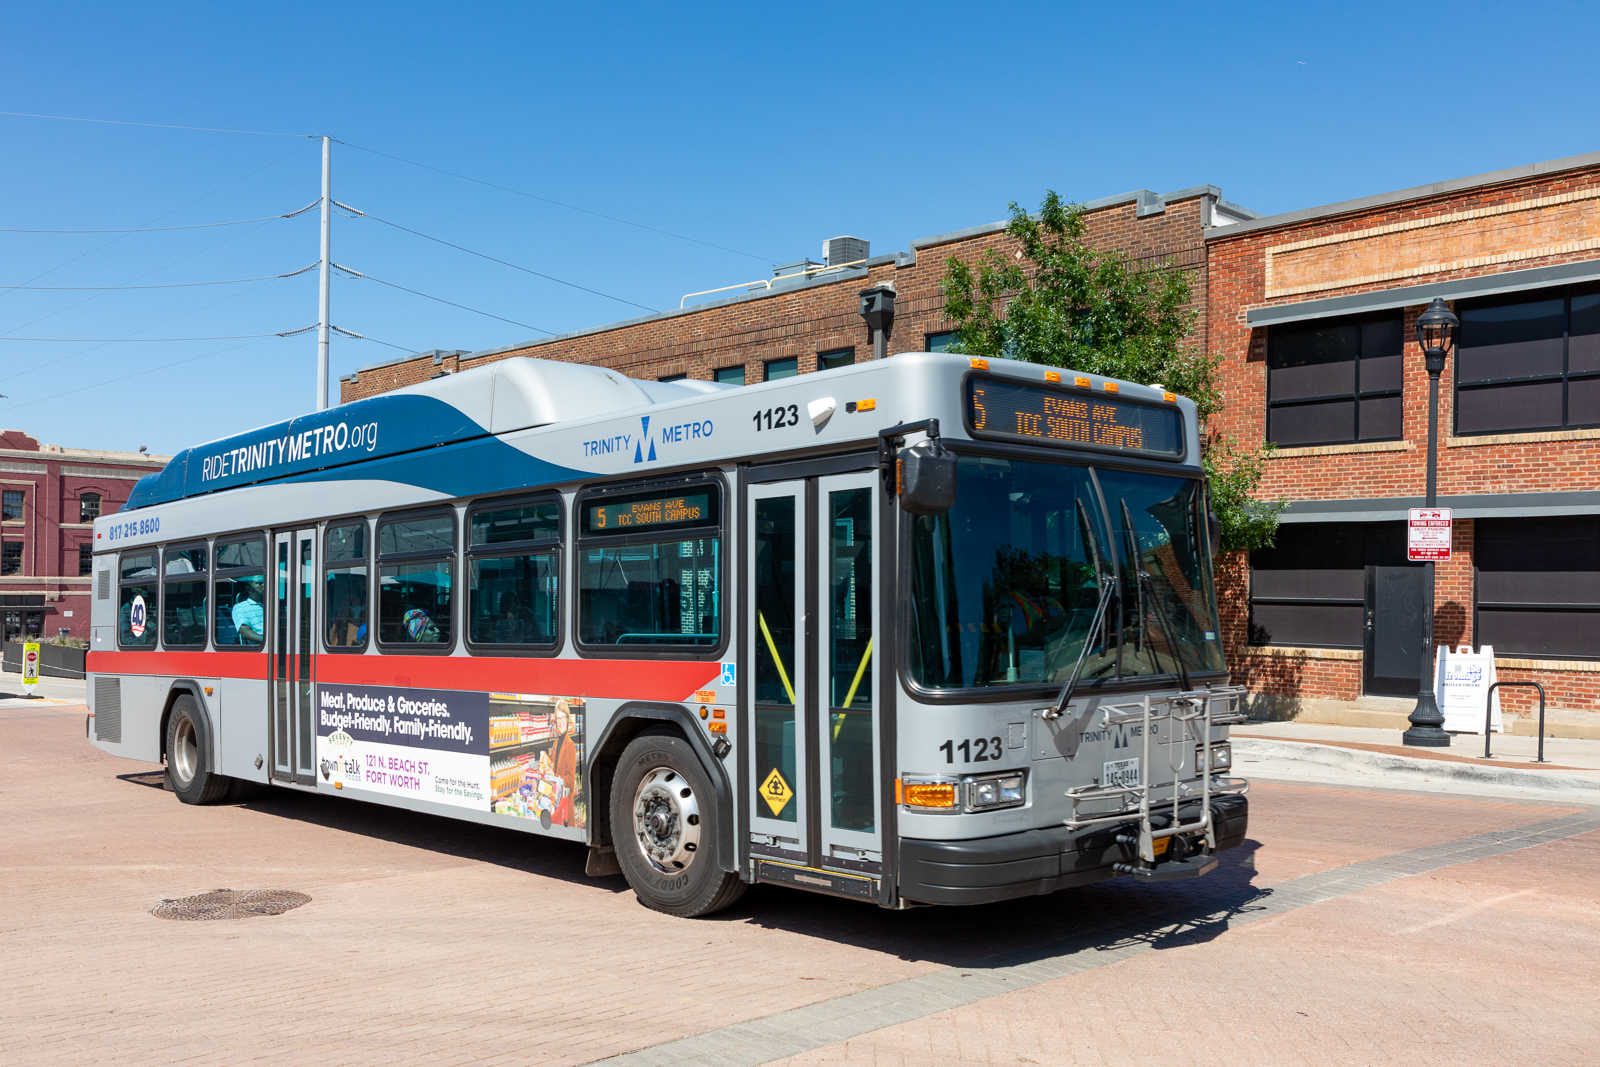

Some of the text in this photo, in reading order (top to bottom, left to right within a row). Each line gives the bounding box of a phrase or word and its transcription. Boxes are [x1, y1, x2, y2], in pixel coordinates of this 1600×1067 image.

[753, 404, 799, 432] 1123
[973, 389, 986, 429] 5
[1044, 397, 1117, 423] EVANS AVE
[583, 420, 713, 457] TRINITY METRO
[1015, 411, 1143, 448] TCC SOUTH CAMPUS
[202, 422, 378, 482] RIDETRINITYMETRO.org
[618, 506, 700, 526] TCC SOUTH CAMPUS
[631, 499, 685, 513] EVANS AVE
[597, 508, 606, 528] 5
[132, 603, 144, 626] 40
[321, 691, 451, 718] Meat, Produce & Groceries.
[320, 709, 474, 745] Budget-Friendly. Family-Friendly.
[1078, 729, 1113, 744] TRINITY
[638, 752, 669, 768] METRO
[939, 736, 1003, 764] 1123
[321, 756, 361, 775] town talk
[365, 754, 430, 775] 121 N. BEACH ST.
[1114, 760, 1129, 768] TEXAS
[346, 773, 361, 782] FOODS
[366, 770, 421, 790] FORT WORTH
[435, 776, 481, 790] Come for the Hunt.
[435, 784, 485, 801] Stay for the Savings.
